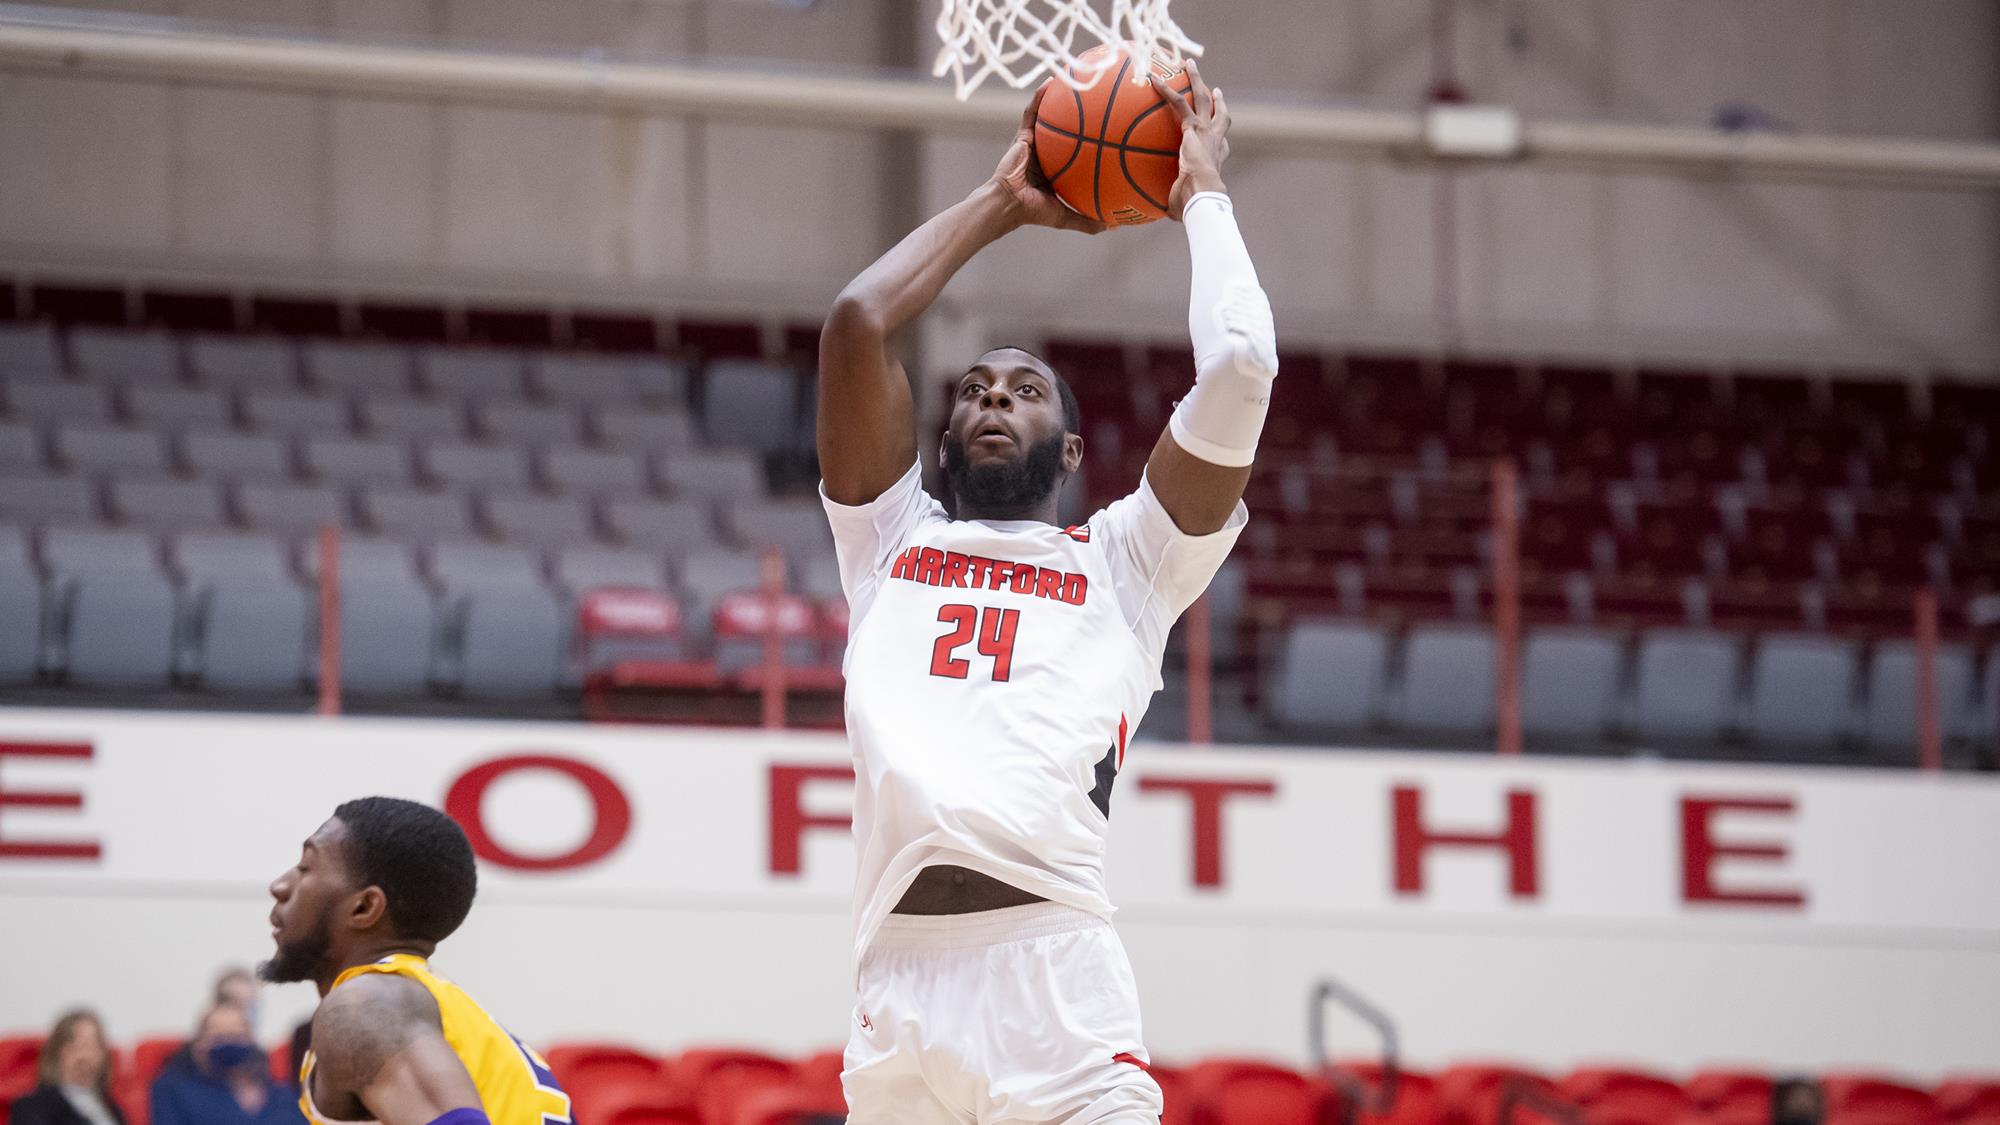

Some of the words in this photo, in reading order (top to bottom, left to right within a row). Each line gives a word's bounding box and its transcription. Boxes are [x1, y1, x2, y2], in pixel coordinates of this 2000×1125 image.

[890, 546, 1088, 606] HARTFORD
[929, 603, 1021, 682] 24
[1138, 776, 1808, 908] THE
